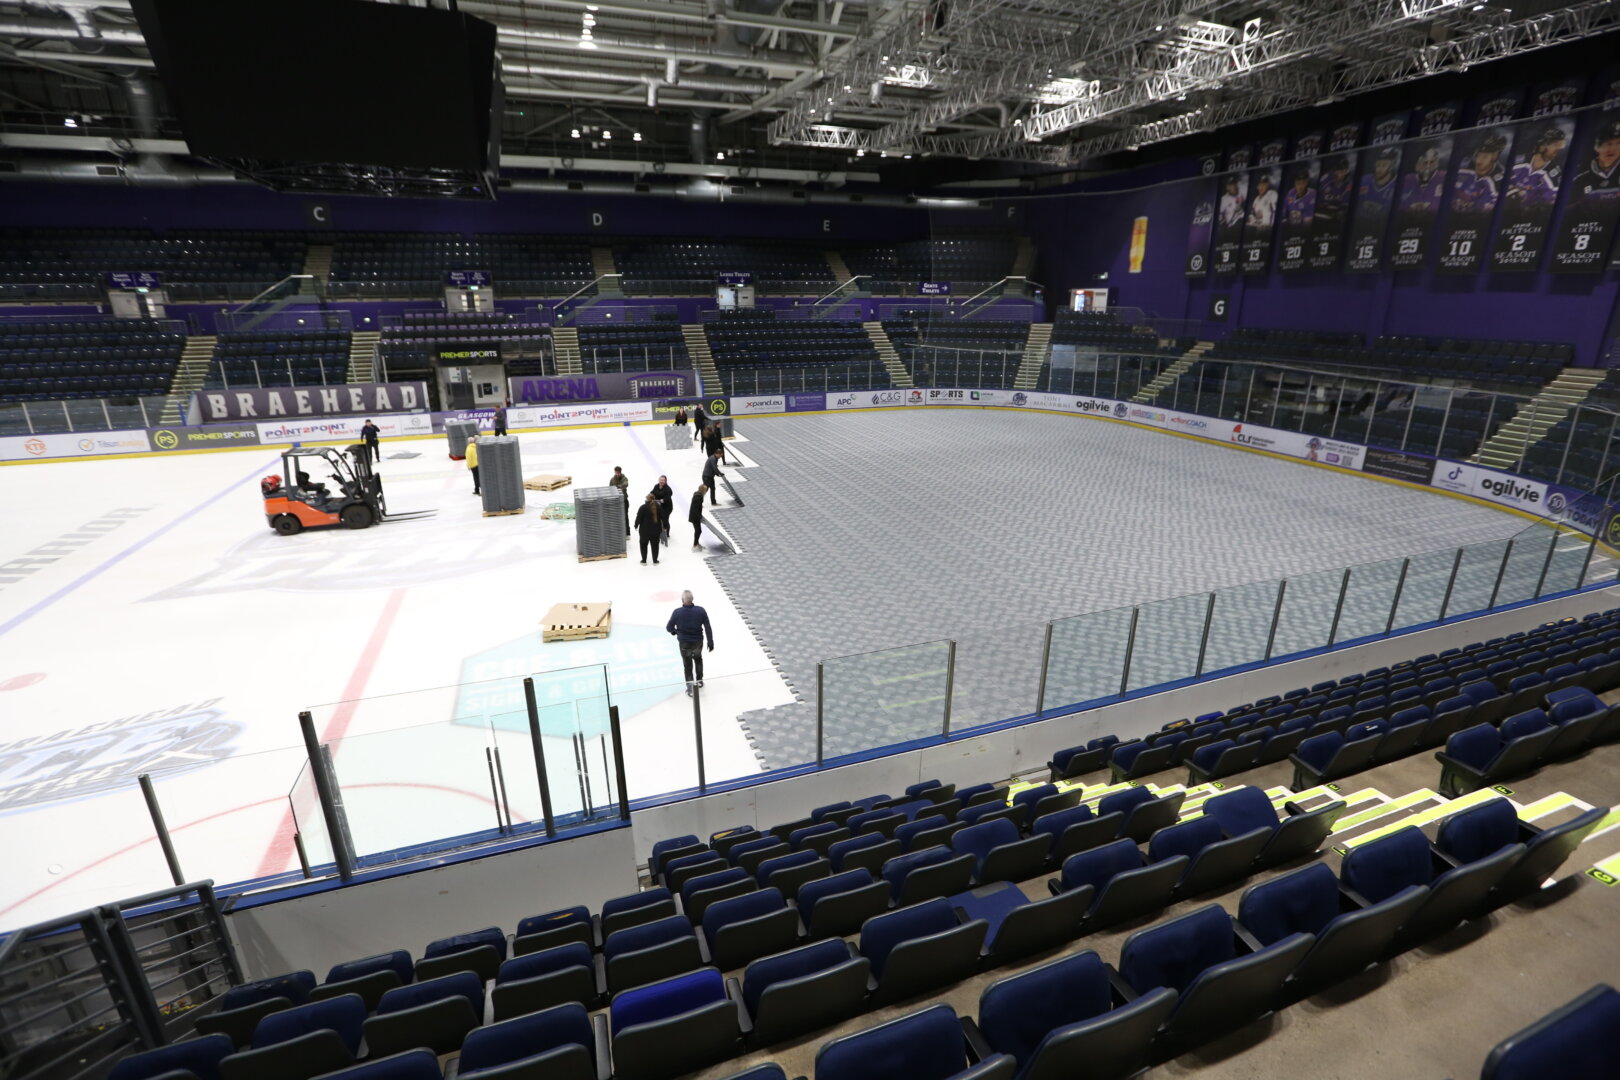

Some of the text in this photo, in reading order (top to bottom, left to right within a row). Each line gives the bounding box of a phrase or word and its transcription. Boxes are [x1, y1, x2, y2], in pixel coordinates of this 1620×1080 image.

[1533, 103, 1573, 117] CLAN
[1476, 114, 1513, 127] CLAN
[1420, 122, 1452, 136] CLAN
[1330, 139, 1356, 152] CLAN
[1372, 133, 1401, 146] CLAN
[312, 206, 325, 222] C
[1007, 207, 1015, 218] F
[592, 213, 603, 226] D
[823, 220, 831, 231] E
[1570, 226, 1604, 234] KEITH
[1494, 250, 1536, 260] SEASON
[1556, 252, 1601, 260] SEASON
[1214, 300, 1225, 315] G
[521, 377, 601, 402] ARENA
[879, 391, 901, 401] C&G
[207, 385, 417, 419] BRAEHEAD
[745, 400, 782, 409] xpand.eu
[837, 398, 852, 406] APC
[1076, 399, 1110, 413] ogilvie
[458, 411, 496, 419] GLASGOW
[541, 408, 607, 422] POINT2POINT
[265, 423, 346, 438] POINT2POINT
[1481, 479, 1539, 503] ogilvie
[1594, 871, 1613, 882] G
